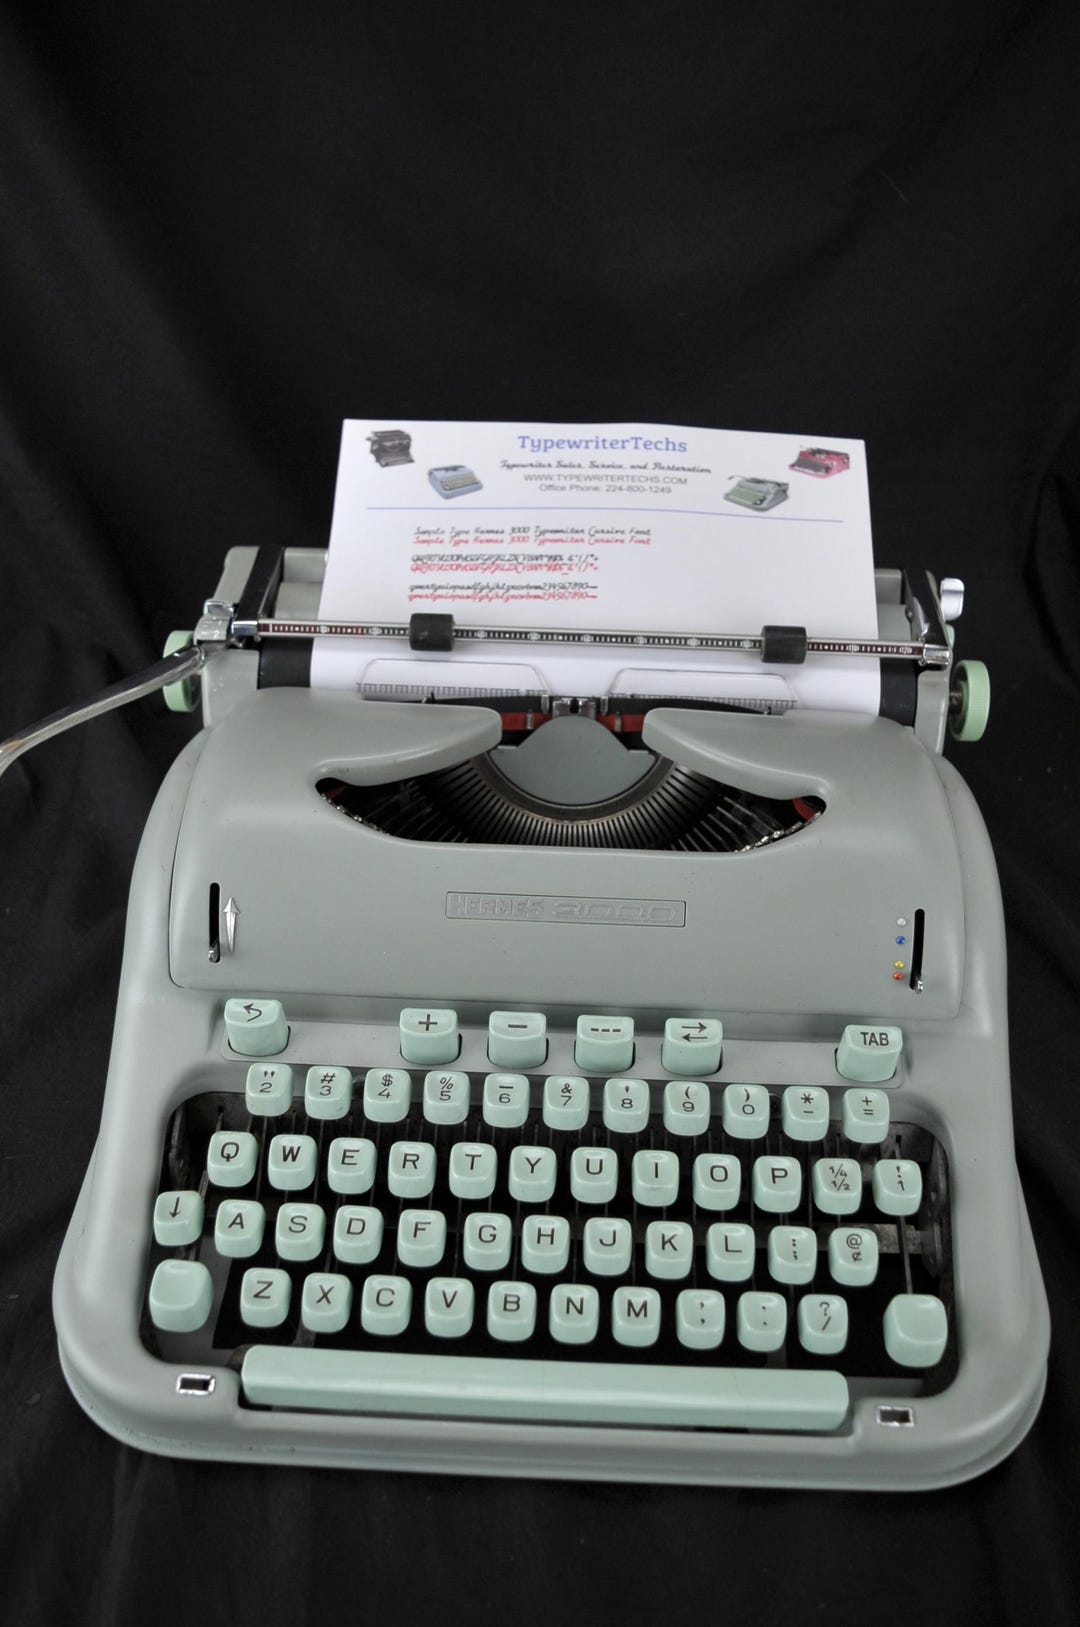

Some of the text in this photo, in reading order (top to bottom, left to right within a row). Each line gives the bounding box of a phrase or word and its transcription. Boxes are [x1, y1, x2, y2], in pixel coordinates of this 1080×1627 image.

[517, 435, 688, 453] TypewriterTechs
[523, 474, 688, 485] WWW.TYPEWRITERTECHS.COM
[539, 484, 567, 493] Office
[605, 485, 672, 494] 224-800-1249
[450, 895, 677, 922] HERMES 3000
[418, 1013, 438, 1032] +
[860, 1032, 889, 1046] TAB
[320, 1073, 336, 1084] #
[380, 1074, 393, 1087] $
[439, 1077, 454, 1089] %
[258, 1082, 273, 1093] 2
[319, 1085, 332, 1096] 3
[377, 1088, 392, 1098] 4
[560, 1083, 573, 1094] &
[439, 1091, 452, 1101] 5
[498, 1093, 511, 1103] 6
[560, 1095, 573, 1106] 7
[620, 1098, 634, 1108] 8
[861, 1097, 873, 1106] +
[681, 1102, 695, 1112] 9
[741, 1104, 756, 1115] 0
[221, 1142, 239, 1162] Q
[283, 1146, 300, 1162] W
[341, 1149, 359, 1165] E
[402, 1154, 419, 1169] R
[465, 1154, 481, 1170] T
[526, 1158, 541, 1173] Y
[586, 1159, 603, 1175] U
[710, 1166, 728, 1182] O
[771, 1168, 788, 1184] P
[897, 1180, 905, 1191] 1
[228, 1213, 244, 1229] A
[289, 1216, 307, 1233] S
[347, 1218, 365, 1235] D
[413, 1222, 431, 1238] F
[479, 1225, 496, 1243] G
[537, 1228, 554, 1245] H
[600, 1230, 616, 1246] J
[662, 1234, 677, 1251] K
[725, 1235, 742, 1253] L
[846, 1234, 862, 1249] @
[253, 1281, 273, 1299] Z
[316, 1286, 334, 1304] X
[376, 1289, 395, 1307] C
[443, 1291, 457, 1308] V
[503, 1294, 520, 1312] B
[566, 1297, 583, 1315] N
[627, 1300, 647, 1318] M
[818, 1302, 833, 1317] ?
